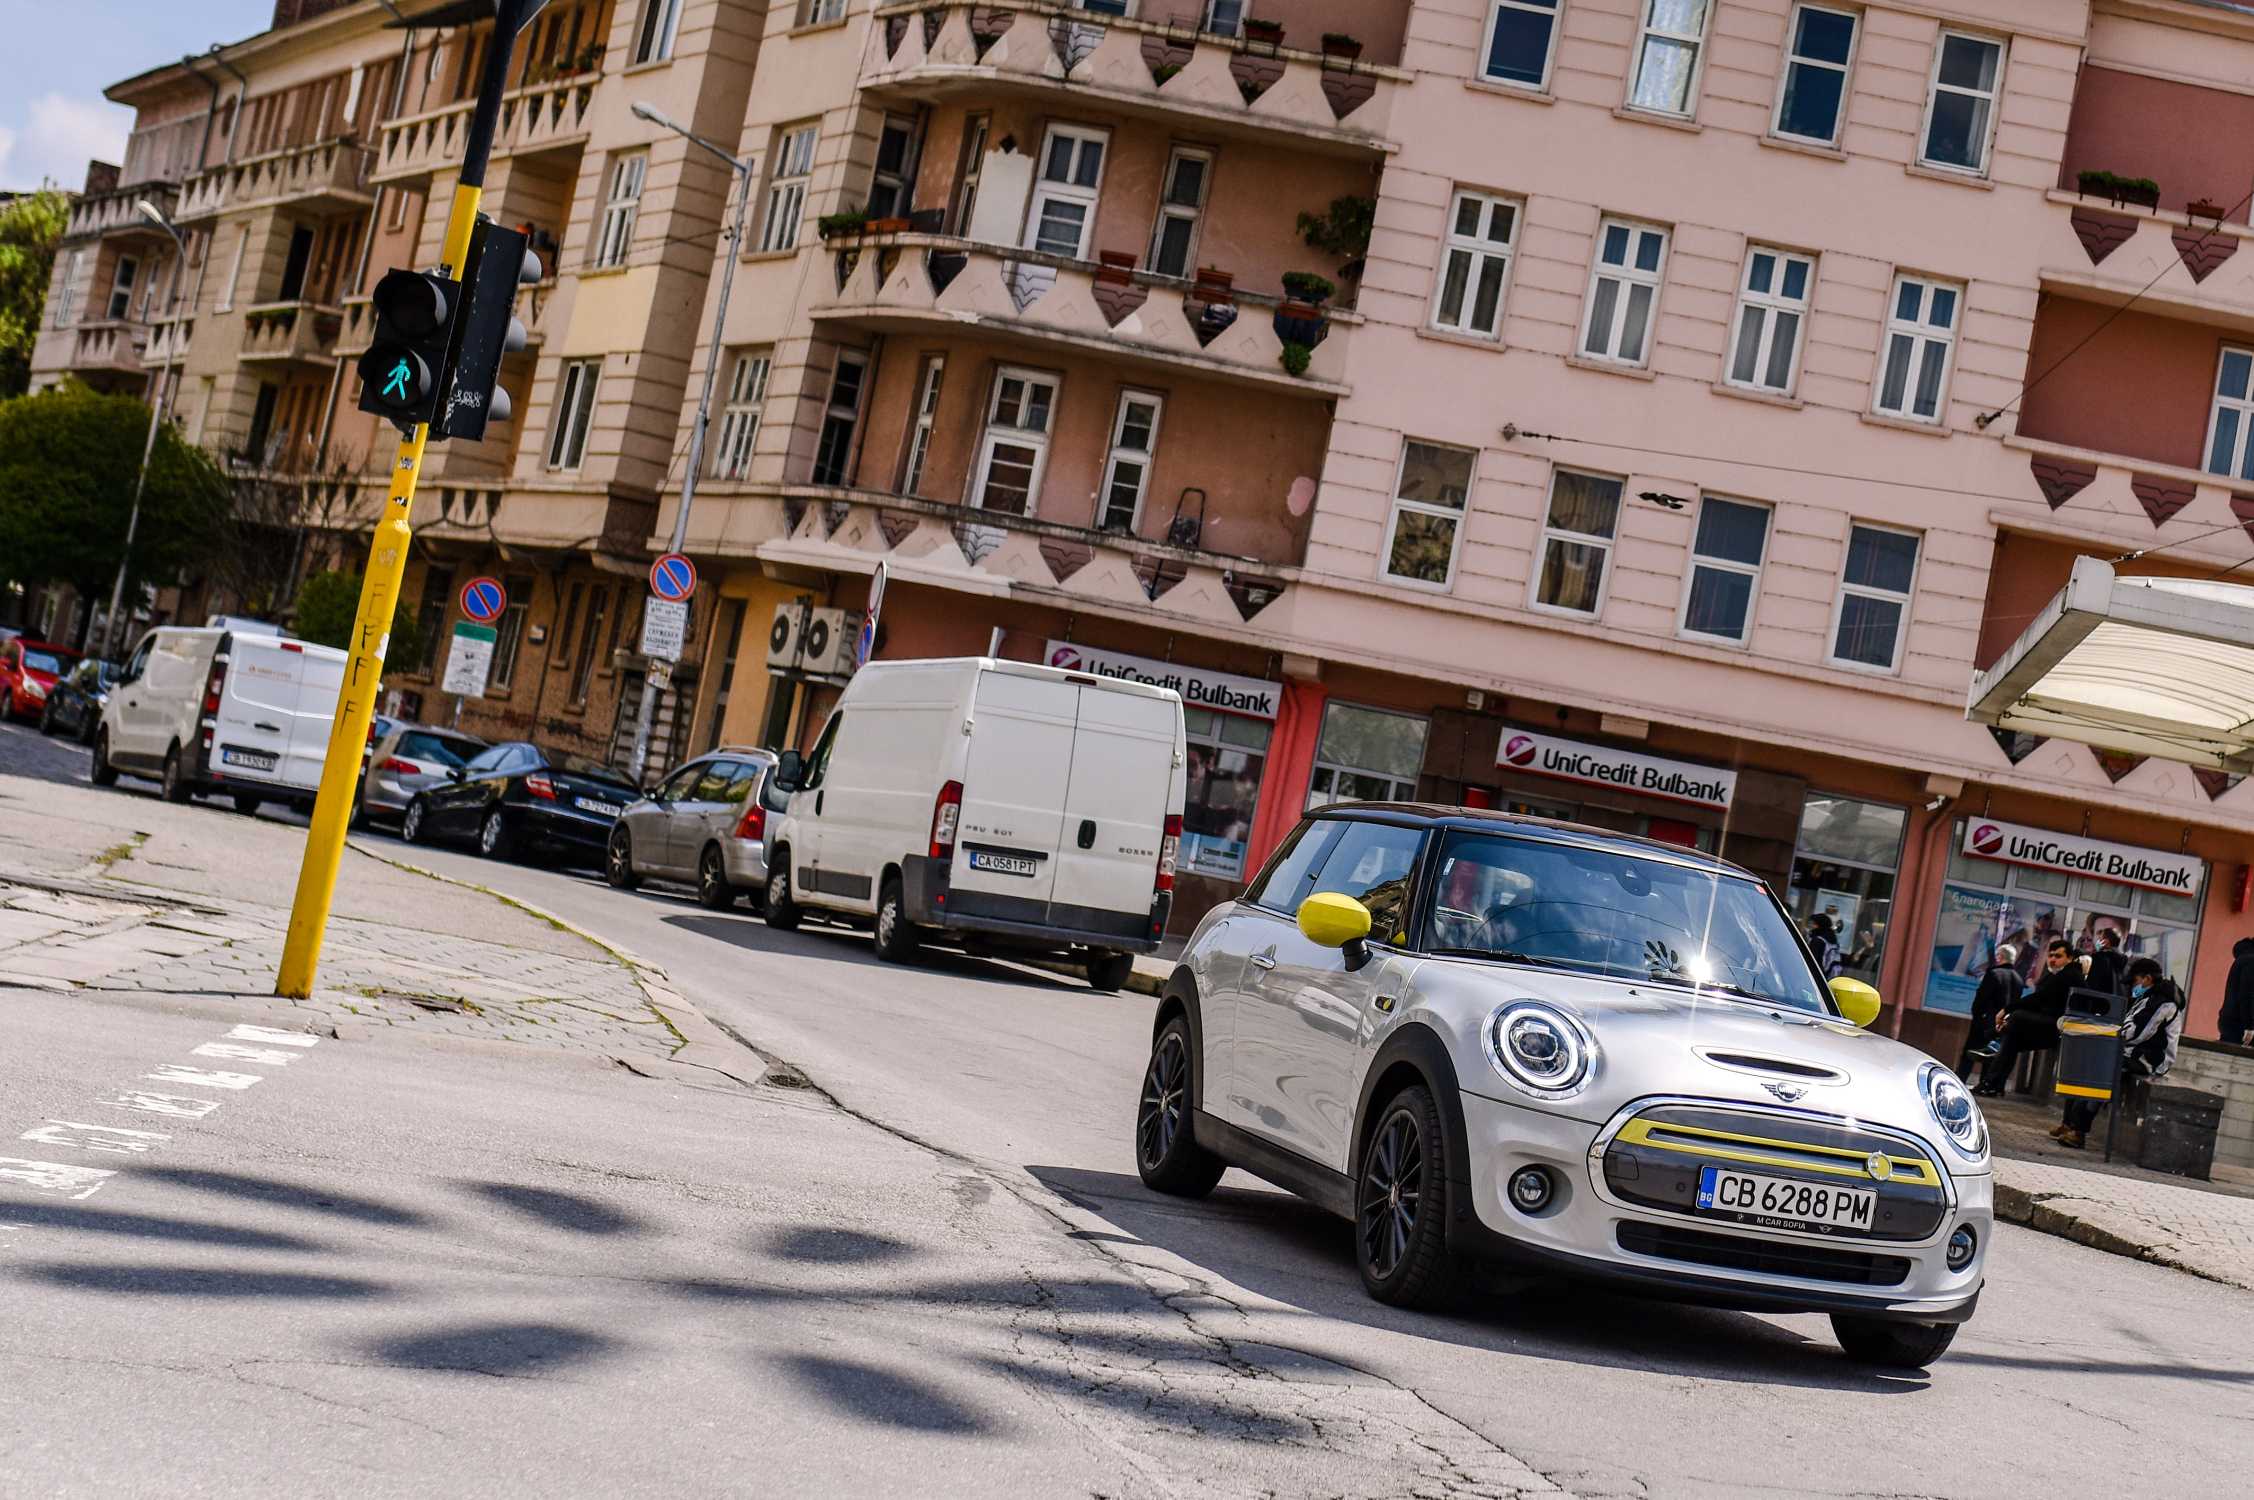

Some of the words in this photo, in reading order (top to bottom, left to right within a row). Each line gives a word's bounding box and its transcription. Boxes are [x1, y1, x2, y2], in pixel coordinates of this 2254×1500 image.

[1186, 679, 1271, 714] Bulbank
[1543, 748, 1638, 785] UniCredit
[1641, 768, 1727, 802] Bulbank
[978, 855, 991, 868] CA
[1019, 861, 1034, 873] PT
[2009, 836, 2103, 873] UniCredit
[2106, 855, 2191, 889] Bulbank
[1700, 1192, 1713, 1202] BG
[1719, 1176, 1756, 1208] CB
[1761, 1182, 1829, 1218] 6288
[1832, 1191, 1871, 1225] PM
[1756, 1216, 1764, 1224] M
[1765, 1218, 1781, 1226] CAR
[1783, 1221, 1806, 1230] SOFIA
